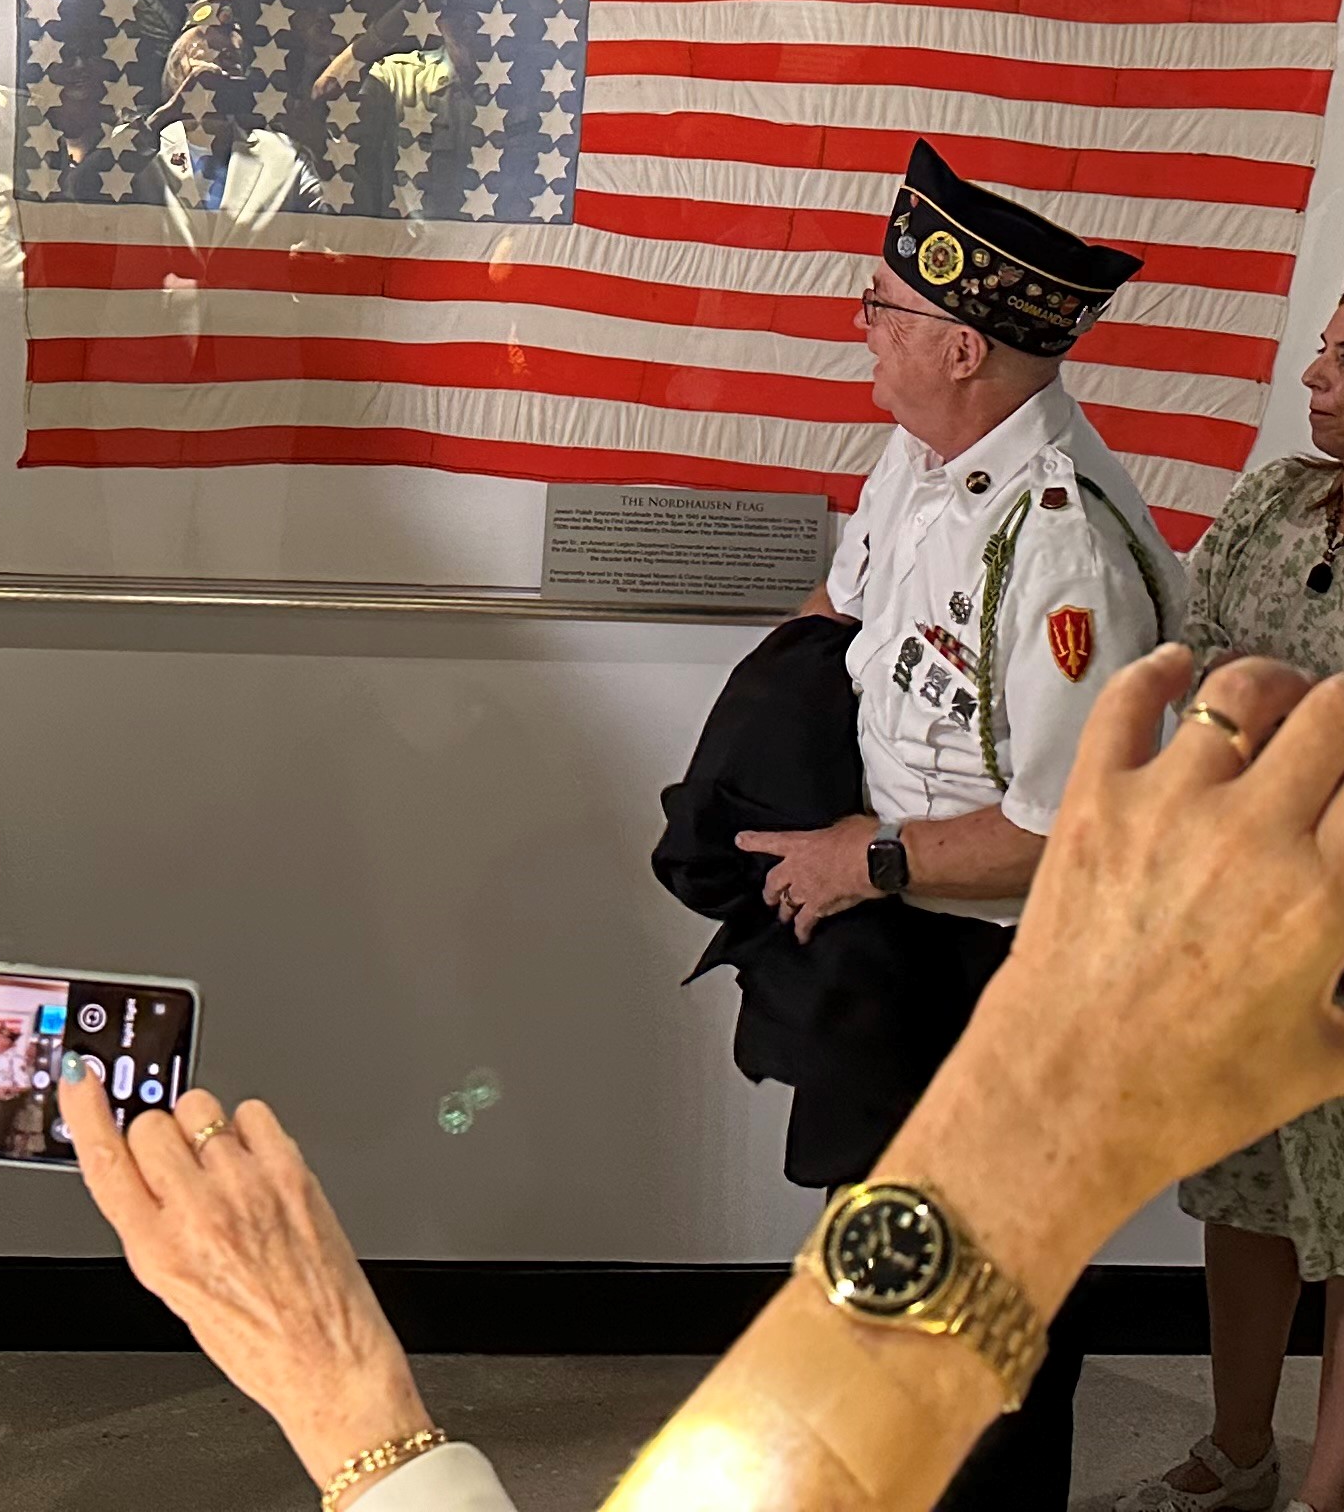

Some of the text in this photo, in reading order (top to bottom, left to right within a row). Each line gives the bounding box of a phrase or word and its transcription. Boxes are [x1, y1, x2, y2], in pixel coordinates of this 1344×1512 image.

[1007, 294, 1074, 327] COMMANDER
[621, 495, 763, 512] THE NORDHAUSEN FLAG
